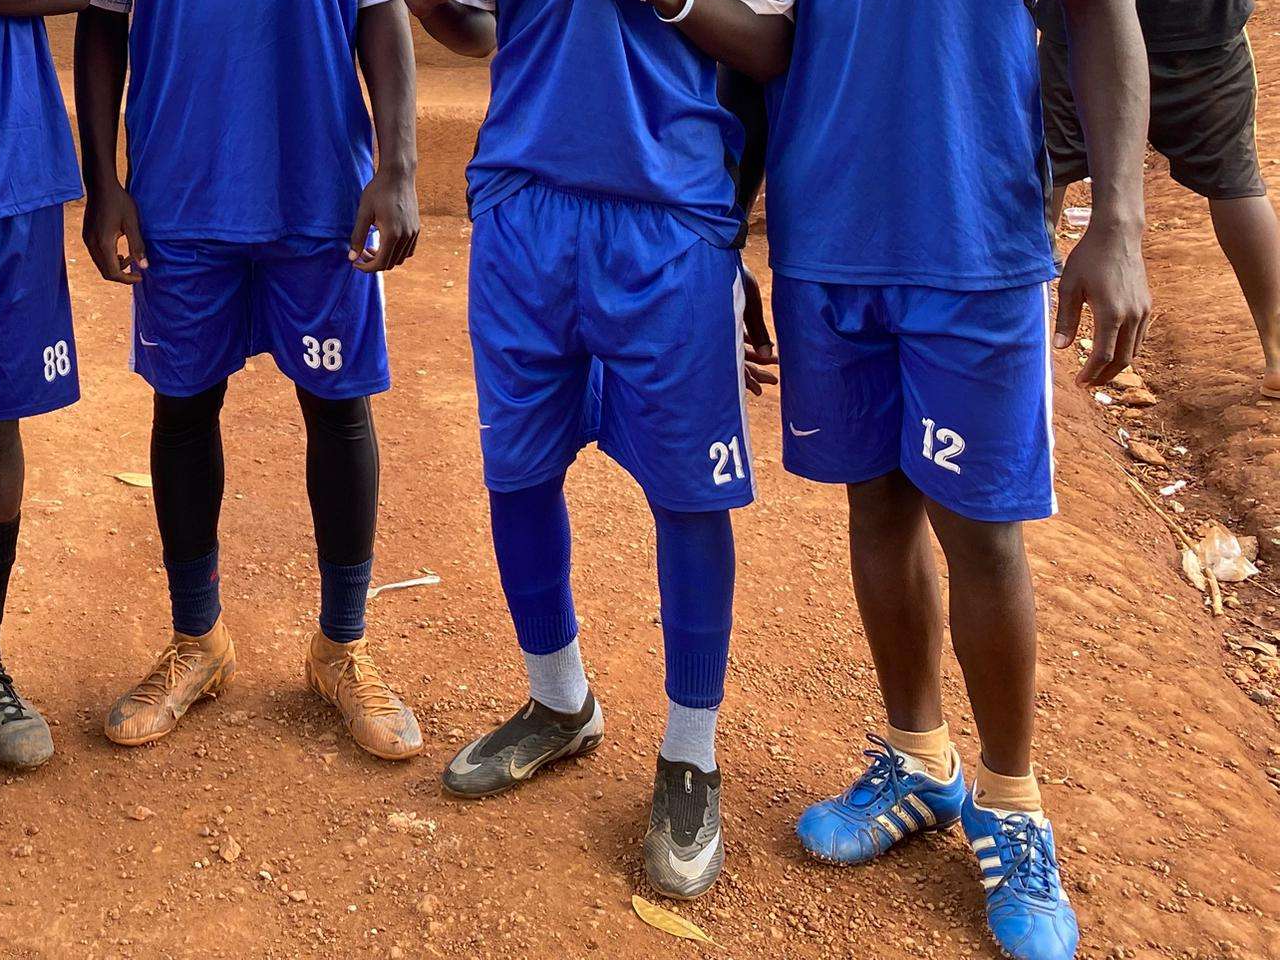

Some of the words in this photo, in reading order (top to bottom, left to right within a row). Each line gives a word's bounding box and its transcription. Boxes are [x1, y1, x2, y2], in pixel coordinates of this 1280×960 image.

[43, 340, 71, 382] 88
[302, 335, 342, 371] 38
[709, 436, 745, 485] 21
[922, 417, 965, 475] 12
